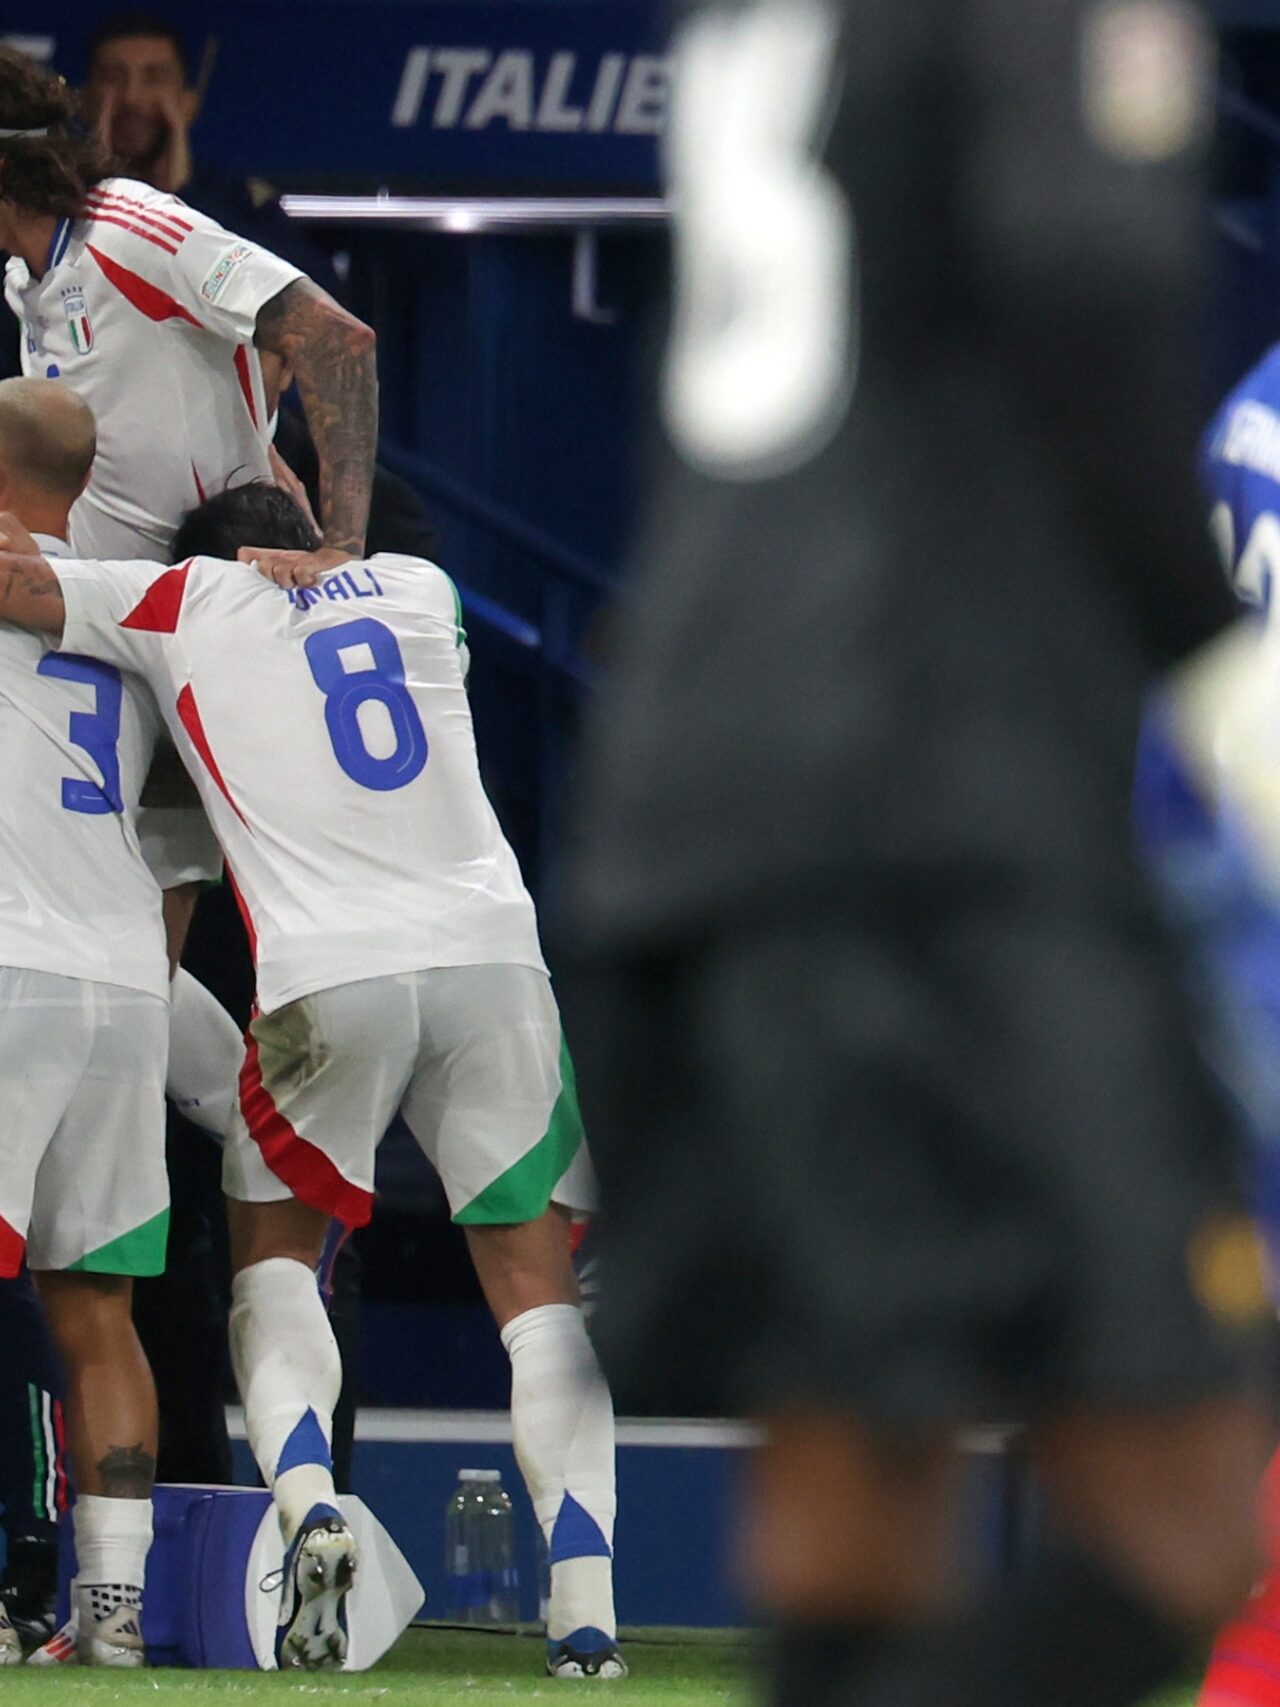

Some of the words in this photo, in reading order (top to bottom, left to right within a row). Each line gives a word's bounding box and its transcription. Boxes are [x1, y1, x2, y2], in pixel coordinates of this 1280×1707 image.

[391, 46, 676, 134] ITALIE
[36, 650, 125, 815] 3
[303, 616, 429, 792] 8
